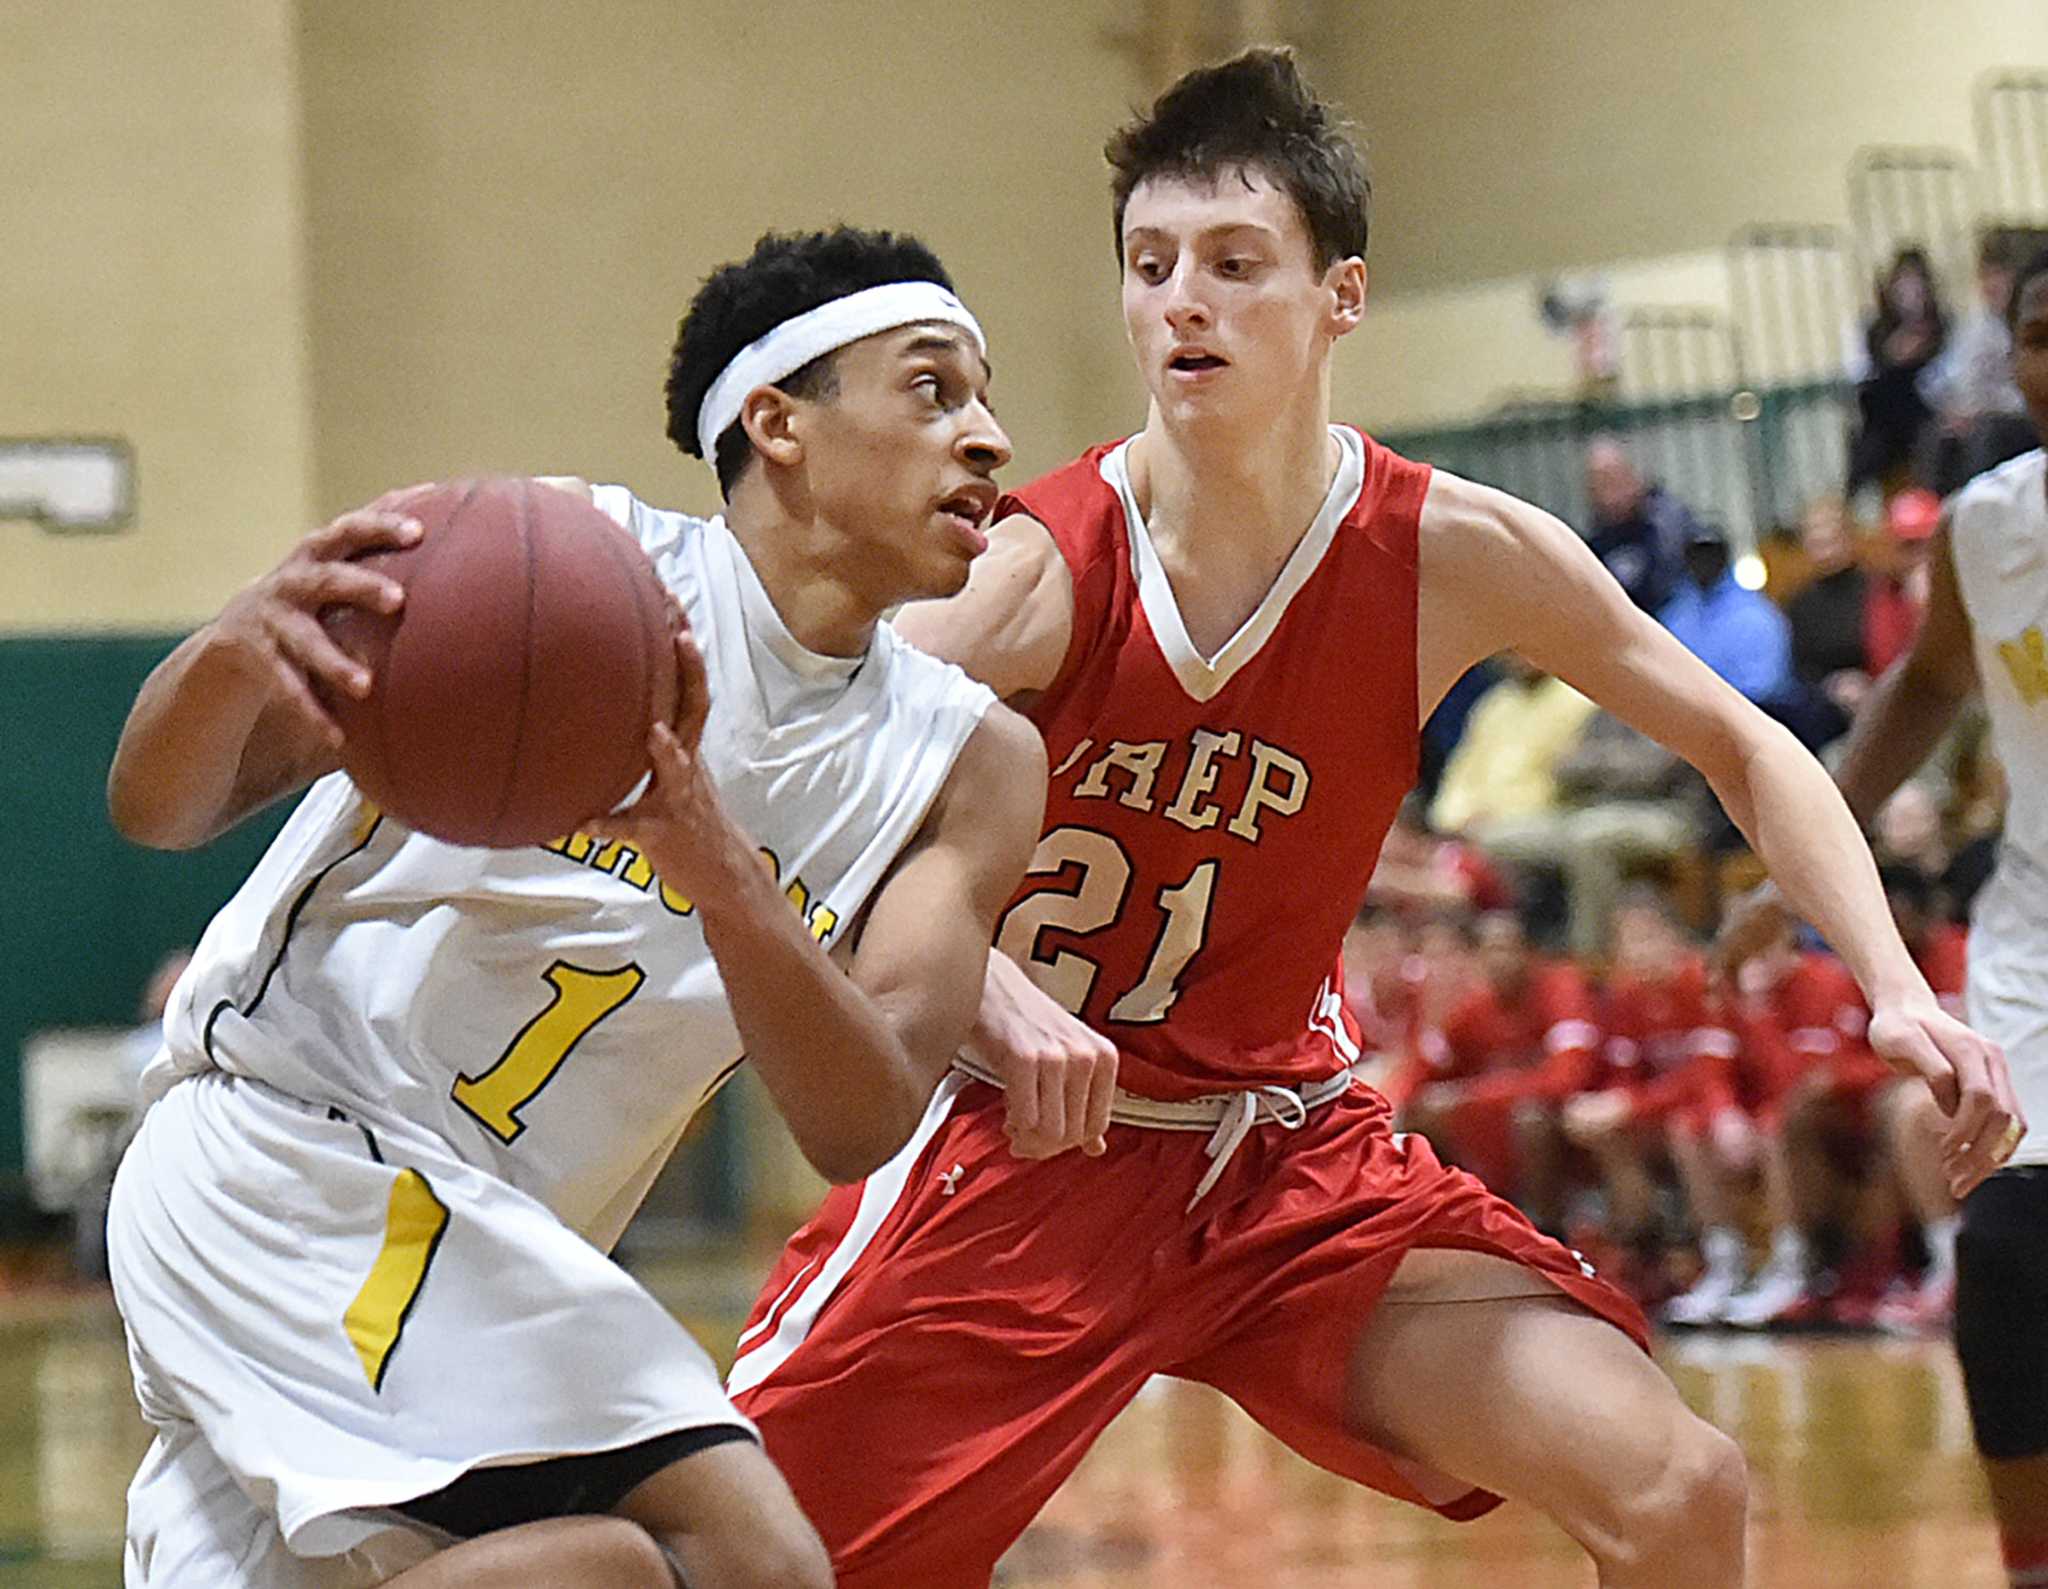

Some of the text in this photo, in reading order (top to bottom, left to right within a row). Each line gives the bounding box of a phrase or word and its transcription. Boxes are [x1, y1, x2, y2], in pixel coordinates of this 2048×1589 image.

[1050, 727, 1312, 844] REP
[993, 823, 1221, 1025] 21
[450, 958, 646, 1146] 1
